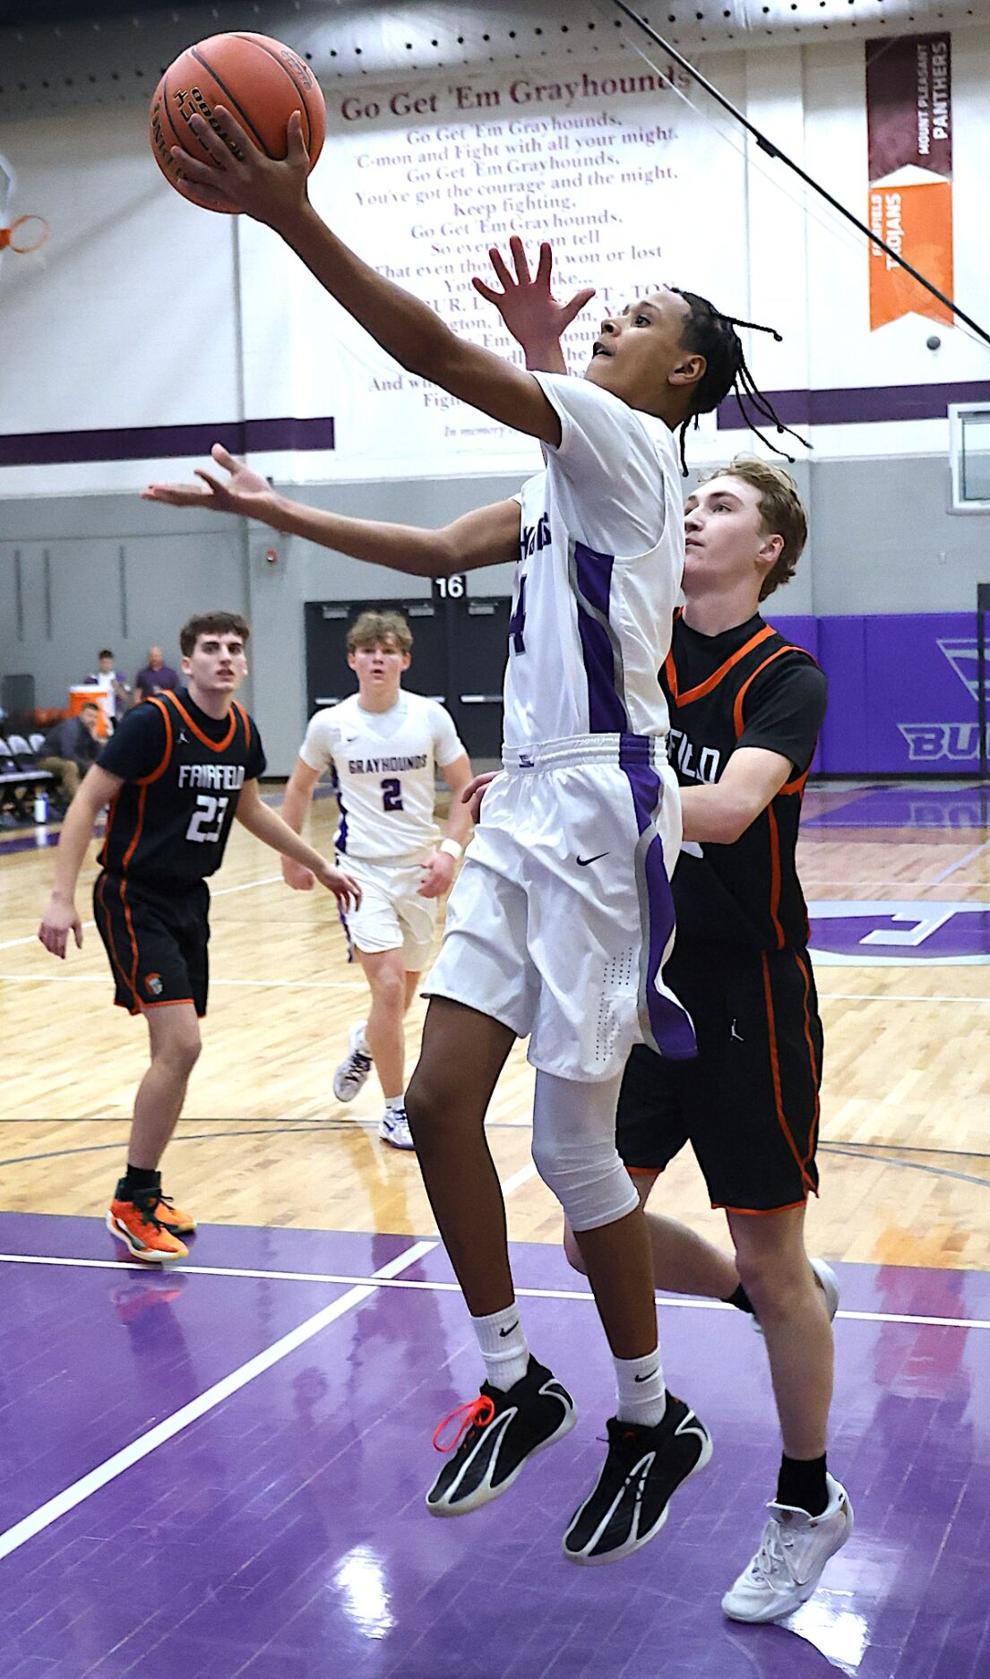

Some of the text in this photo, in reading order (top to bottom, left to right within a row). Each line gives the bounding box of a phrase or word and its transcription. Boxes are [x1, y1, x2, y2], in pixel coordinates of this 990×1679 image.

[341, 97, 380, 121] Go
[390, 92, 438, 116] Get
[509, 65, 691, 108] Grayhounds
[917, 44, 930, 155] MOUNT PLEASANT
[932, 41, 948, 140] PANTHERS
[406, 129, 431, 145] Go
[436, 126, 465, 142] Get
[418, 147, 448, 163] and
[455, 143, 499, 160] Fight
[505, 138, 541, 153] with
[547, 135, 569, 151] all
[576, 135, 617, 154] your
[406, 168, 431, 183] Go
[436, 166, 465, 180] Get
[416, 188, 441, 206] got
[448, 184, 473, 198] the
[477, 179, 546, 197] courage
[551, 173, 582, 190] and
[588, 171, 616, 186] the
[453, 202, 496, 220] Keep
[410, 225, 435, 240] Go
[441, 222, 470, 237] Get
[431, 243, 451, 257] So
[456, 239, 535, 257] everye
[573, 230, 600, 245] tell
[416, 263, 454, 278] even
[606, 251, 625, 262] or
[631, 245, 662, 260] lost
[369, 374, 403, 392] And
[435, 575, 463, 598] 16
[897, 723, 990, 760] BU
[381, 778, 404, 811] 2
